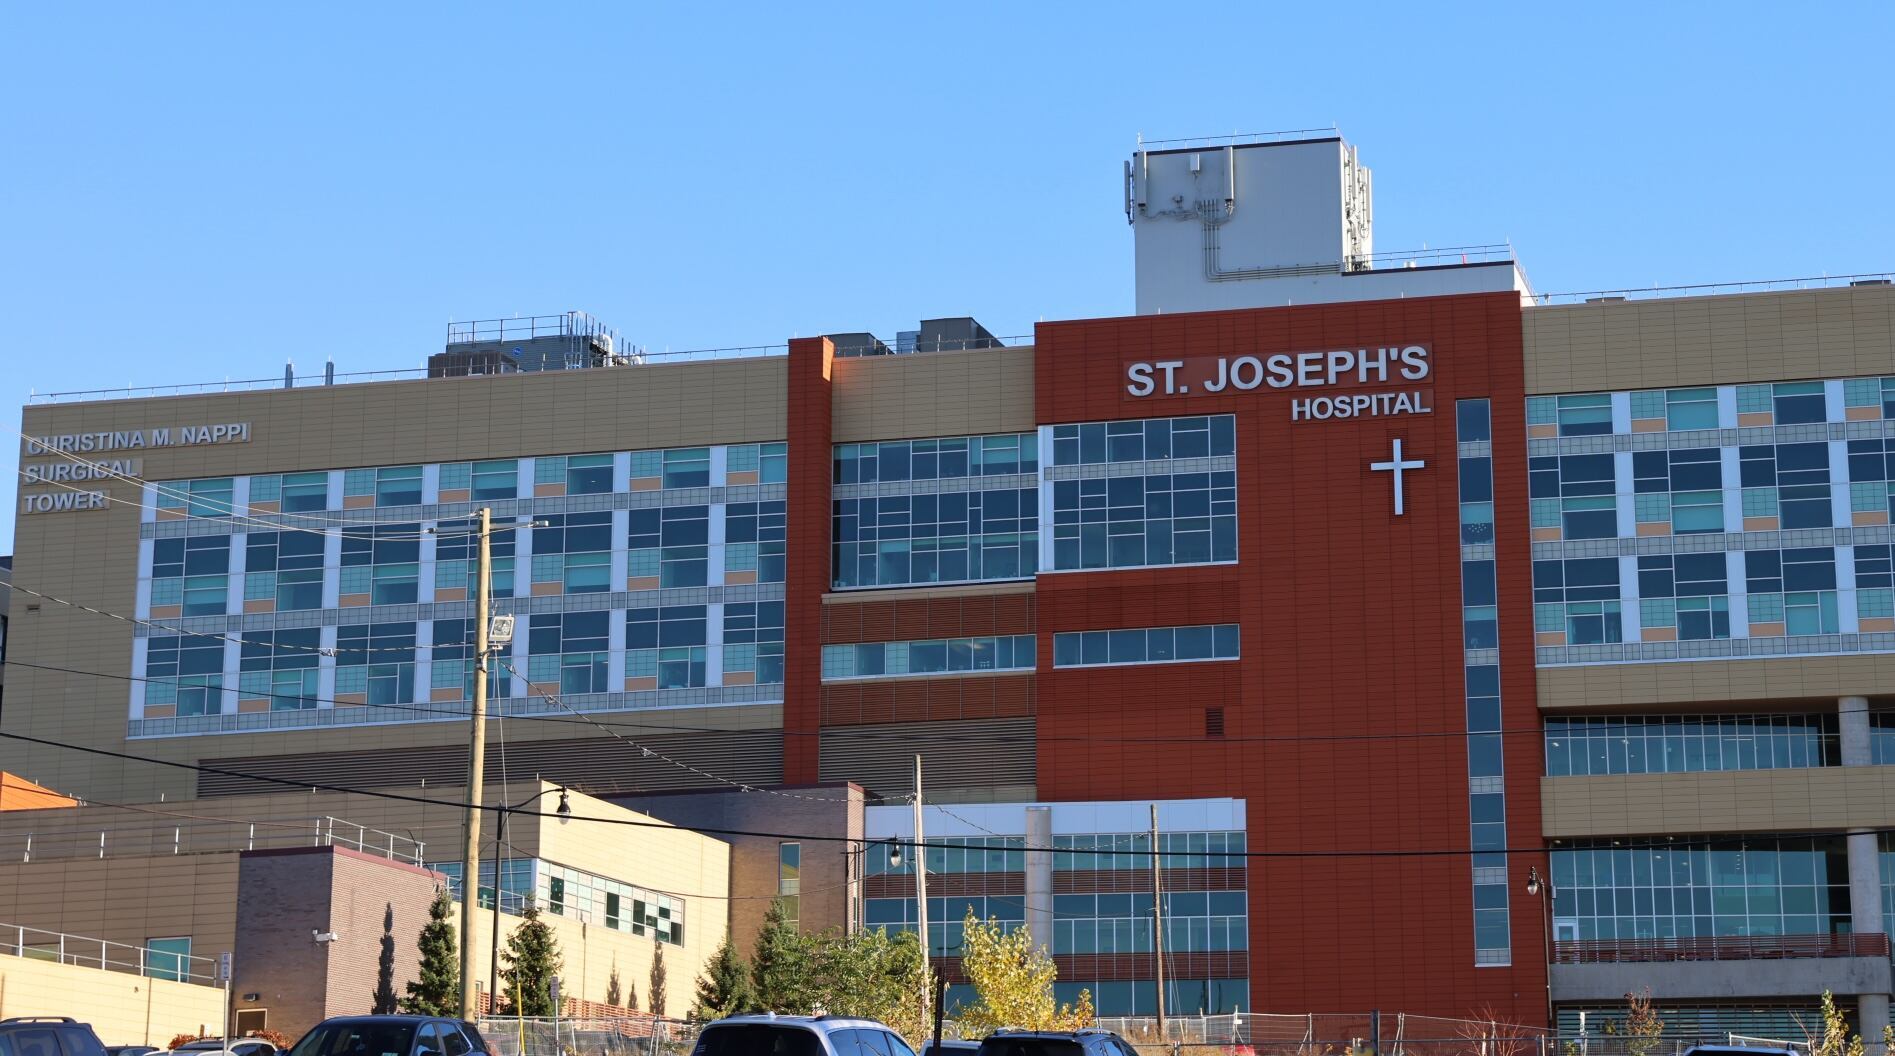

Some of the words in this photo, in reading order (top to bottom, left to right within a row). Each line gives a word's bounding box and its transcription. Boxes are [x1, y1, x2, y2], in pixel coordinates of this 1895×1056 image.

[1127, 361, 1188, 397] ST.
[1204, 346, 1429, 392] JOSEPH'S
[1292, 391, 1431, 421] HOSPITAL
[27, 430, 146, 454] CHRISTINA
[151, 428, 175, 447] M.
[181, 423, 248, 444] NAPPI
[25, 459, 139, 484] SURGICAL
[24, 489, 106, 513] TOWER
